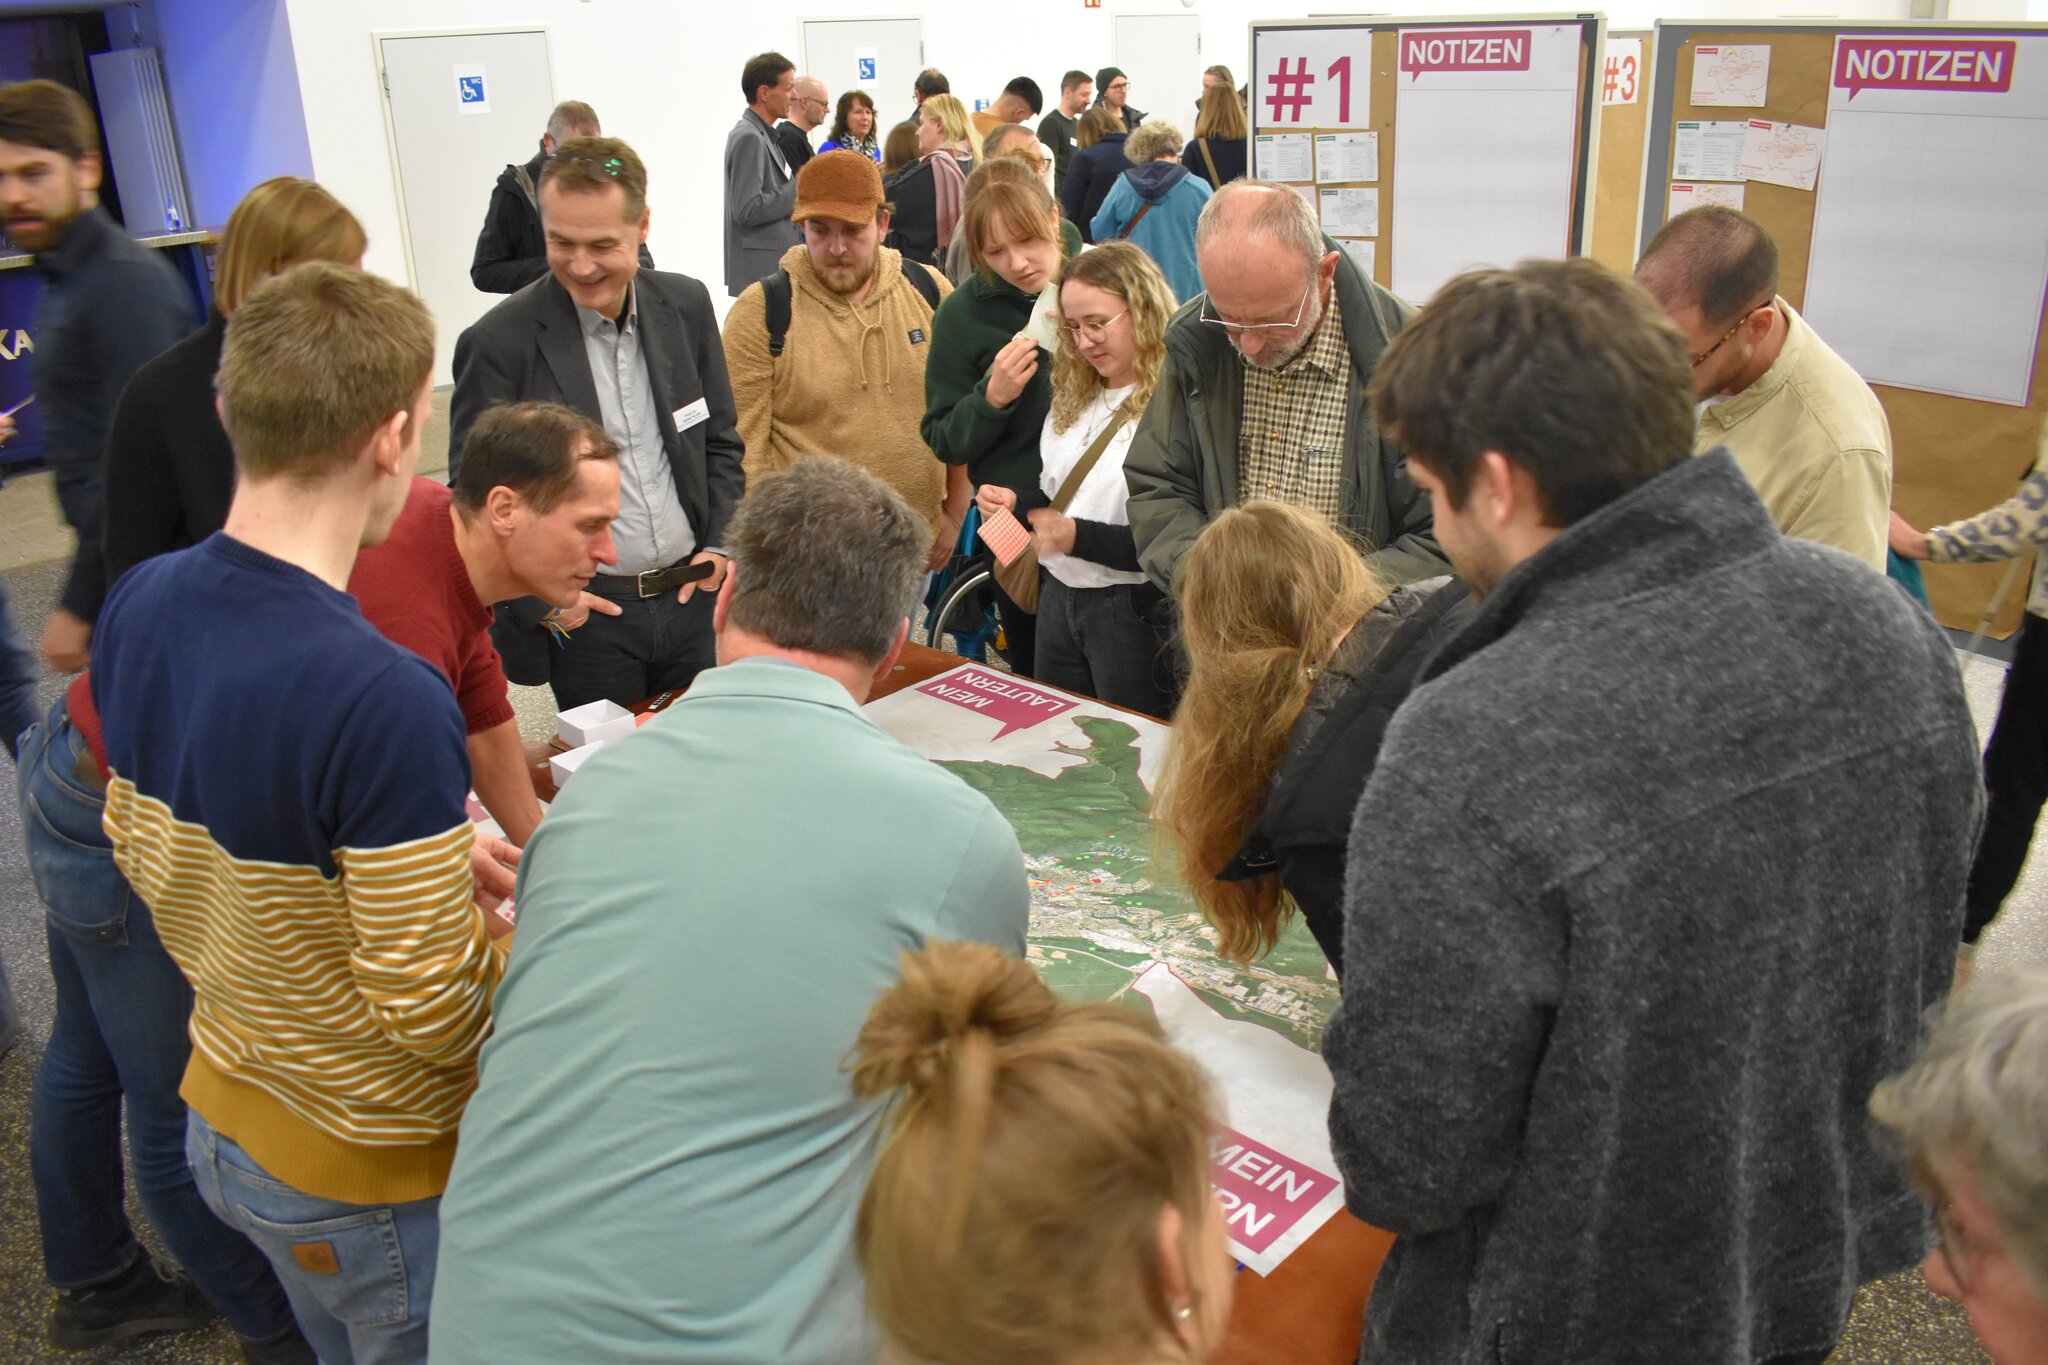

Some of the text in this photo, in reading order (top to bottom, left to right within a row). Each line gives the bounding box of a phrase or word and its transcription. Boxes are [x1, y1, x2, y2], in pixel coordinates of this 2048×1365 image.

[1408, 38, 1522, 64] NOTIZEN
[1845, 49, 2002, 83] NOTIZEN
[1265, 56, 1350, 123] #1
[1602, 56, 1636, 101] #3
[928, 683, 995, 708] MEIN
[955, 672, 1066, 712] LAUTERN
[1208, 1134, 1314, 1203] MEIN
